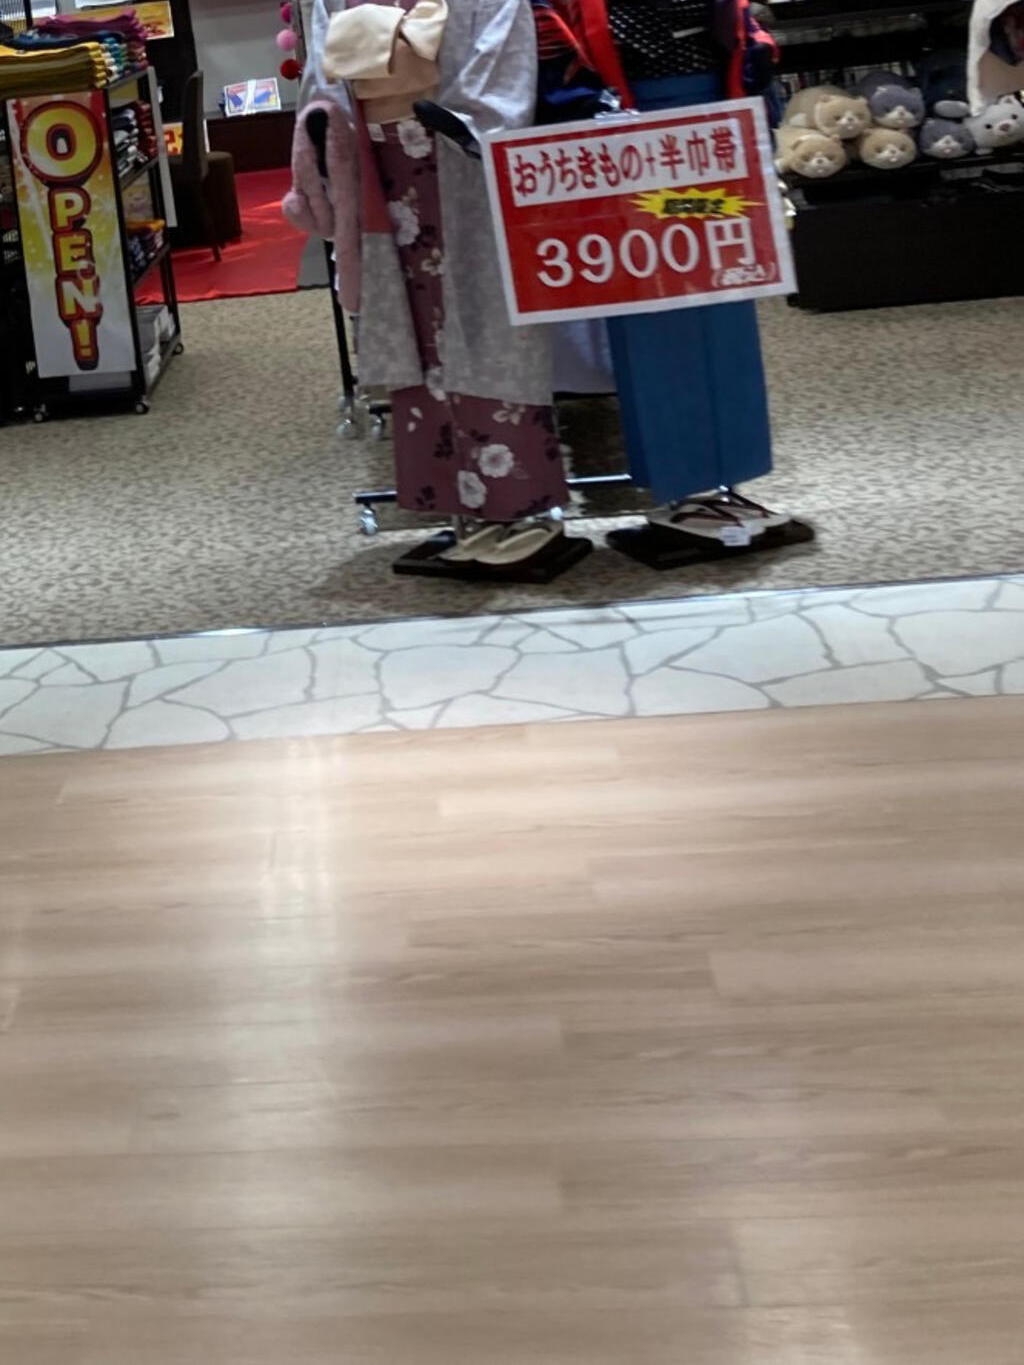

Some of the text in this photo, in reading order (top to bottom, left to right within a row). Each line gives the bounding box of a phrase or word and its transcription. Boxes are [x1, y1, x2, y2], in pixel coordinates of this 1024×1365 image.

[514, 126, 738, 199] おうちきもの+半巾帯
[19, 99, 104, 371] OPEN!
[535, 217, 757, 288] 3900円
